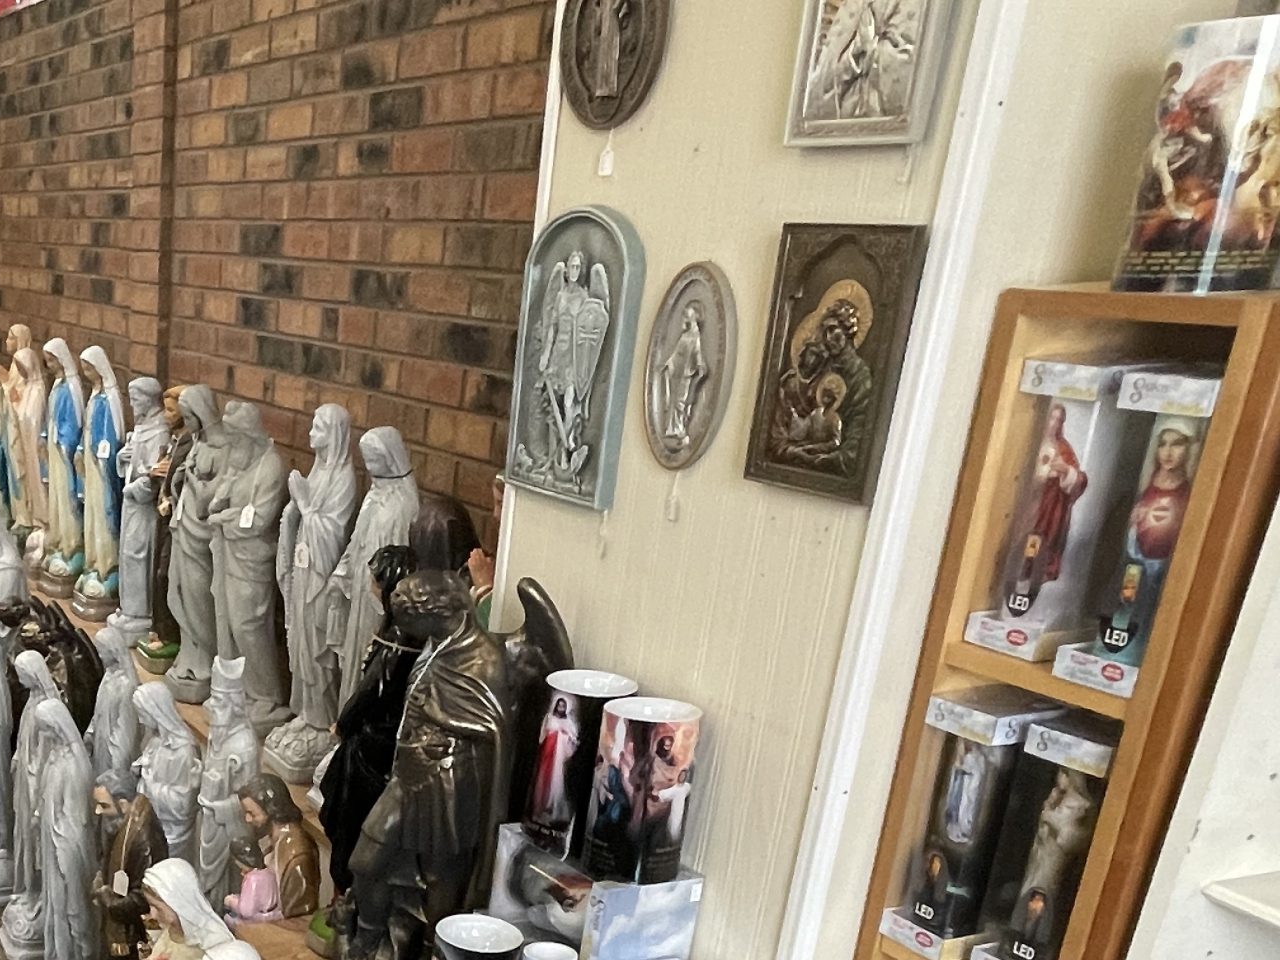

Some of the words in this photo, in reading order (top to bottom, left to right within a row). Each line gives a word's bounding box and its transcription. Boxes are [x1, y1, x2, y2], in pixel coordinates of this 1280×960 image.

[1008, 593, 1030, 611] LED
[1104, 627, 1129, 647] LED
[914, 902, 935, 920] LED
[1012, 941, 1035, 960] LED
